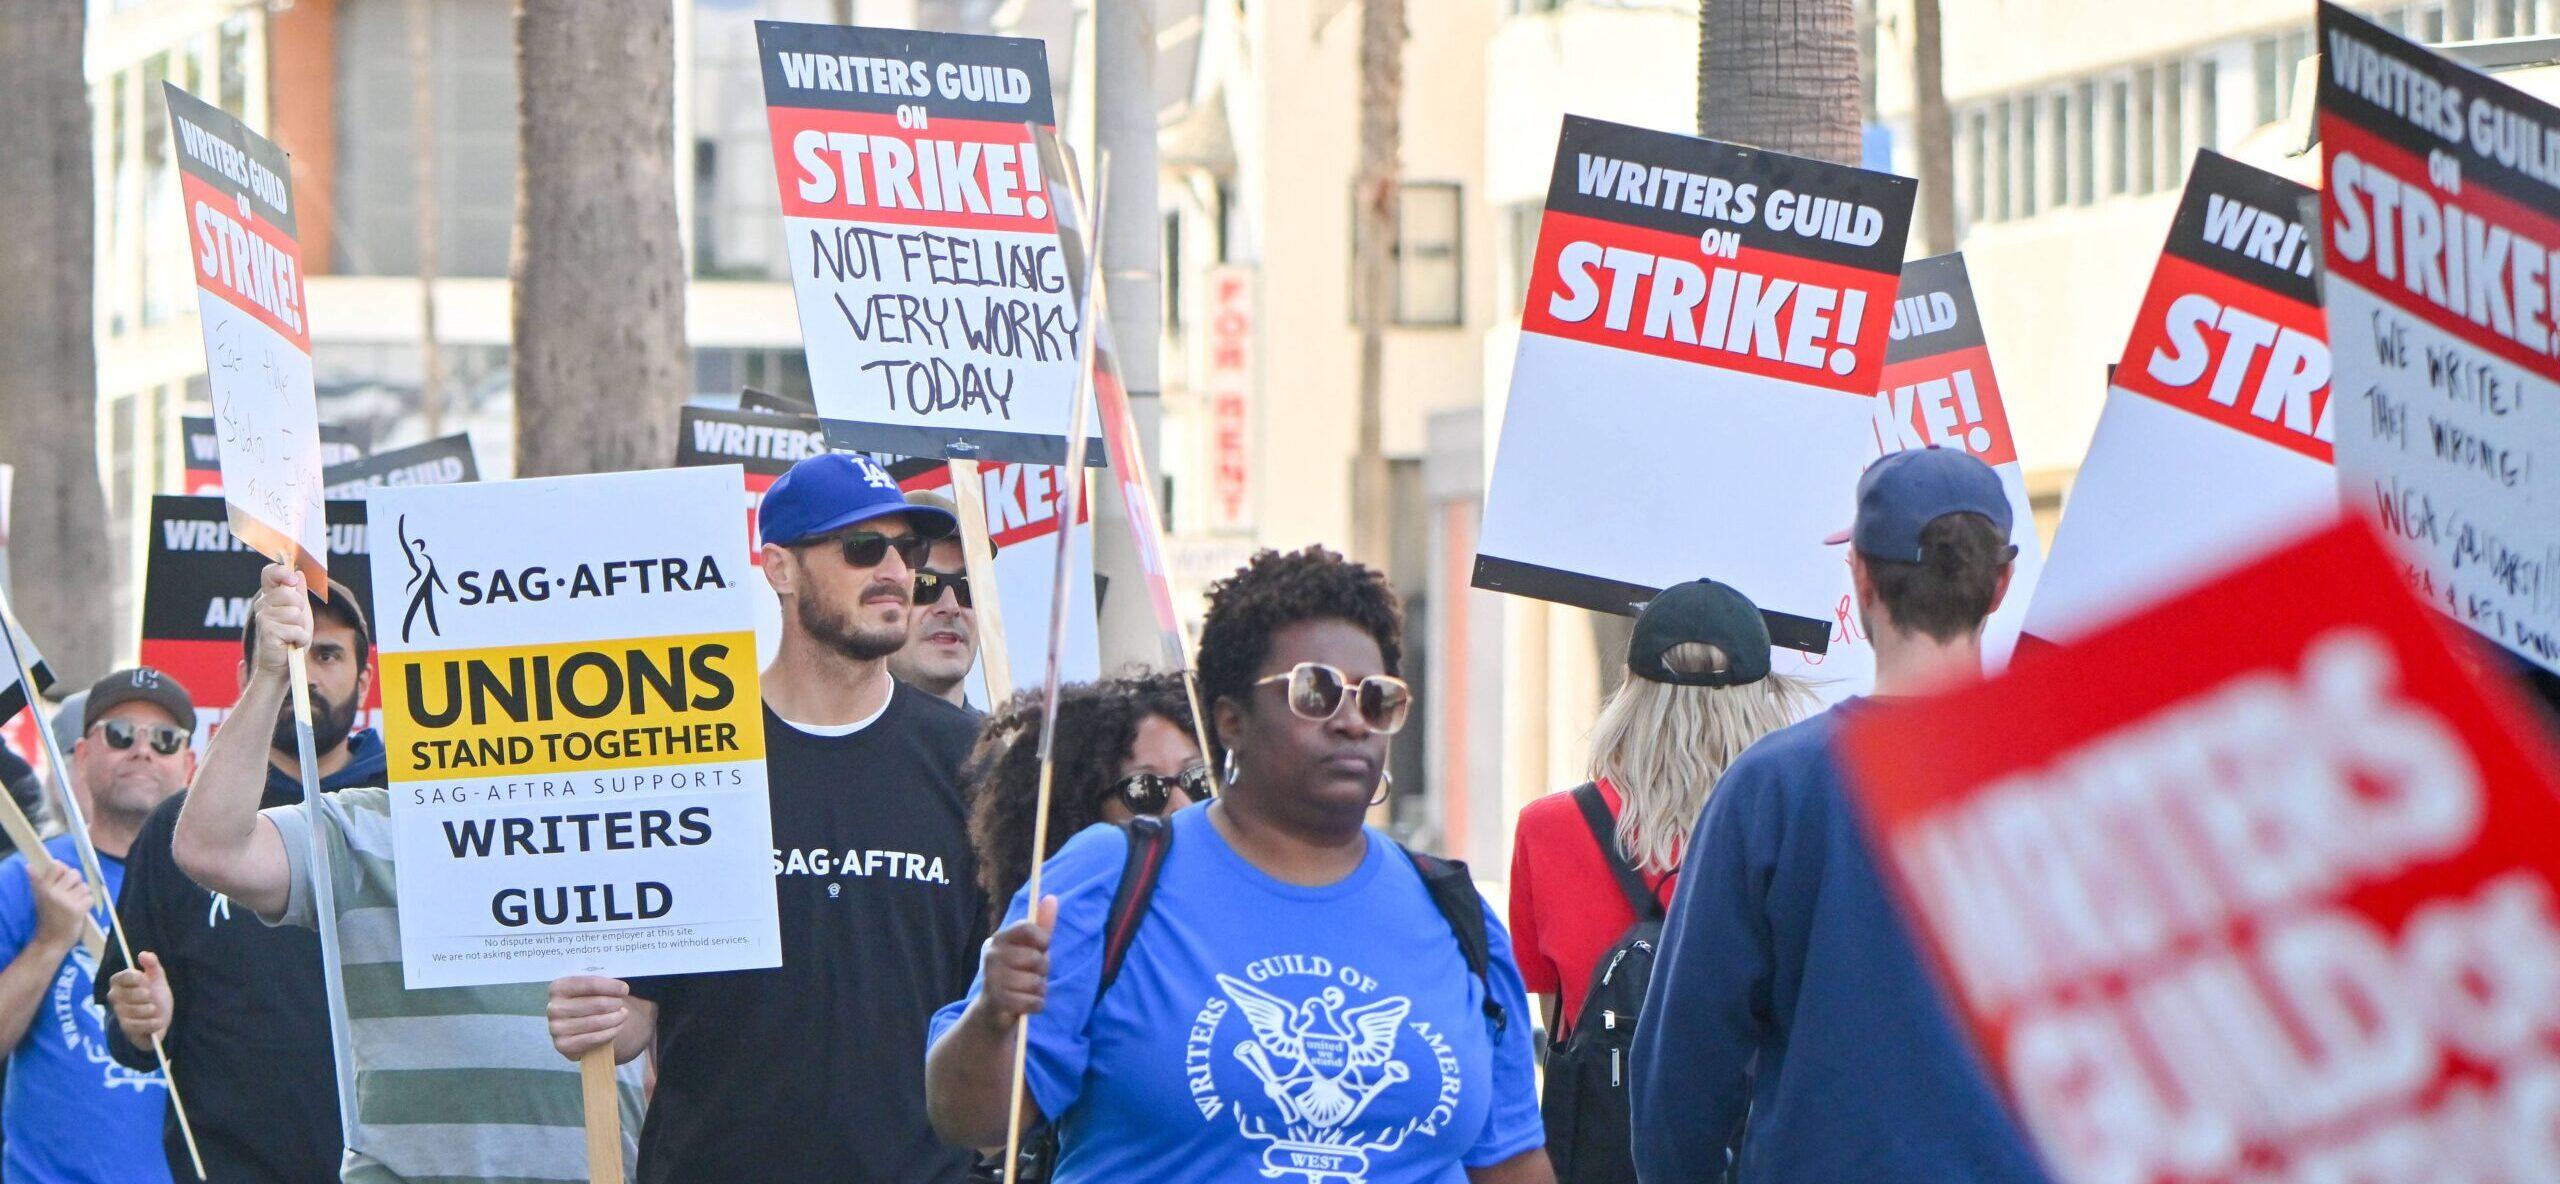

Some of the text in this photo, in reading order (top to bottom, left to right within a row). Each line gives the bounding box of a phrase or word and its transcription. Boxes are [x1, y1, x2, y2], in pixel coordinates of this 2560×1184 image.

[778, 51, 1031, 105] WRITERS GUILD
[2328, 28, 2464, 144] WRITERS
[896, 104, 928, 130] ON
[178, 116, 288, 215] WRITERS GUILD
[793, 129, 1048, 220] STRIKE!
[2428, 148, 2462, 195] ON
[237, 192, 253, 221] ON
[1577, 152, 1884, 248] WRITERS GUILD
[195, 199, 302, 336] STRIKE!
[811, 226, 1065, 294] NOT FEELING
[1700, 228, 1741, 260] ON
[834, 292, 1080, 362] VERY WORKY
[1548, 241, 1868, 377] STRIKE!
[861, 357, 1014, 420] TODAY
[692, 420, 825, 464] WRITERS
[850, 457, 896, 490] LA
[404, 643, 735, 729] UNIONS
[411, 722, 740, 771] STAND TOGETHER
[414, 769, 743, 805] SAG-AFTRA SUPPORTS
[442, 807, 713, 859] WRITERS
[491, 880, 674, 928] GUILD
[433, 953, 447, 962] We
[449, 953, 463, 961] are
[466, 951, 481, 960] not
[483, 949, 512, 960] asking
[513, 946, 564, 958] employees,
[566, 943, 601, 955] vendors
[615, 940, 655, 953] suppliers
[658, 940, 668, 949] to
[670, 936, 710, 948] withhold
[711, 935, 750, 946] services.
[484, 927, 696, 948] No dispute with any other employer at this site.
[1186, 954, 1461, 1137] WRITERS GUILD OF AMERICA
[1290, 1152, 1343, 1171] WEST
